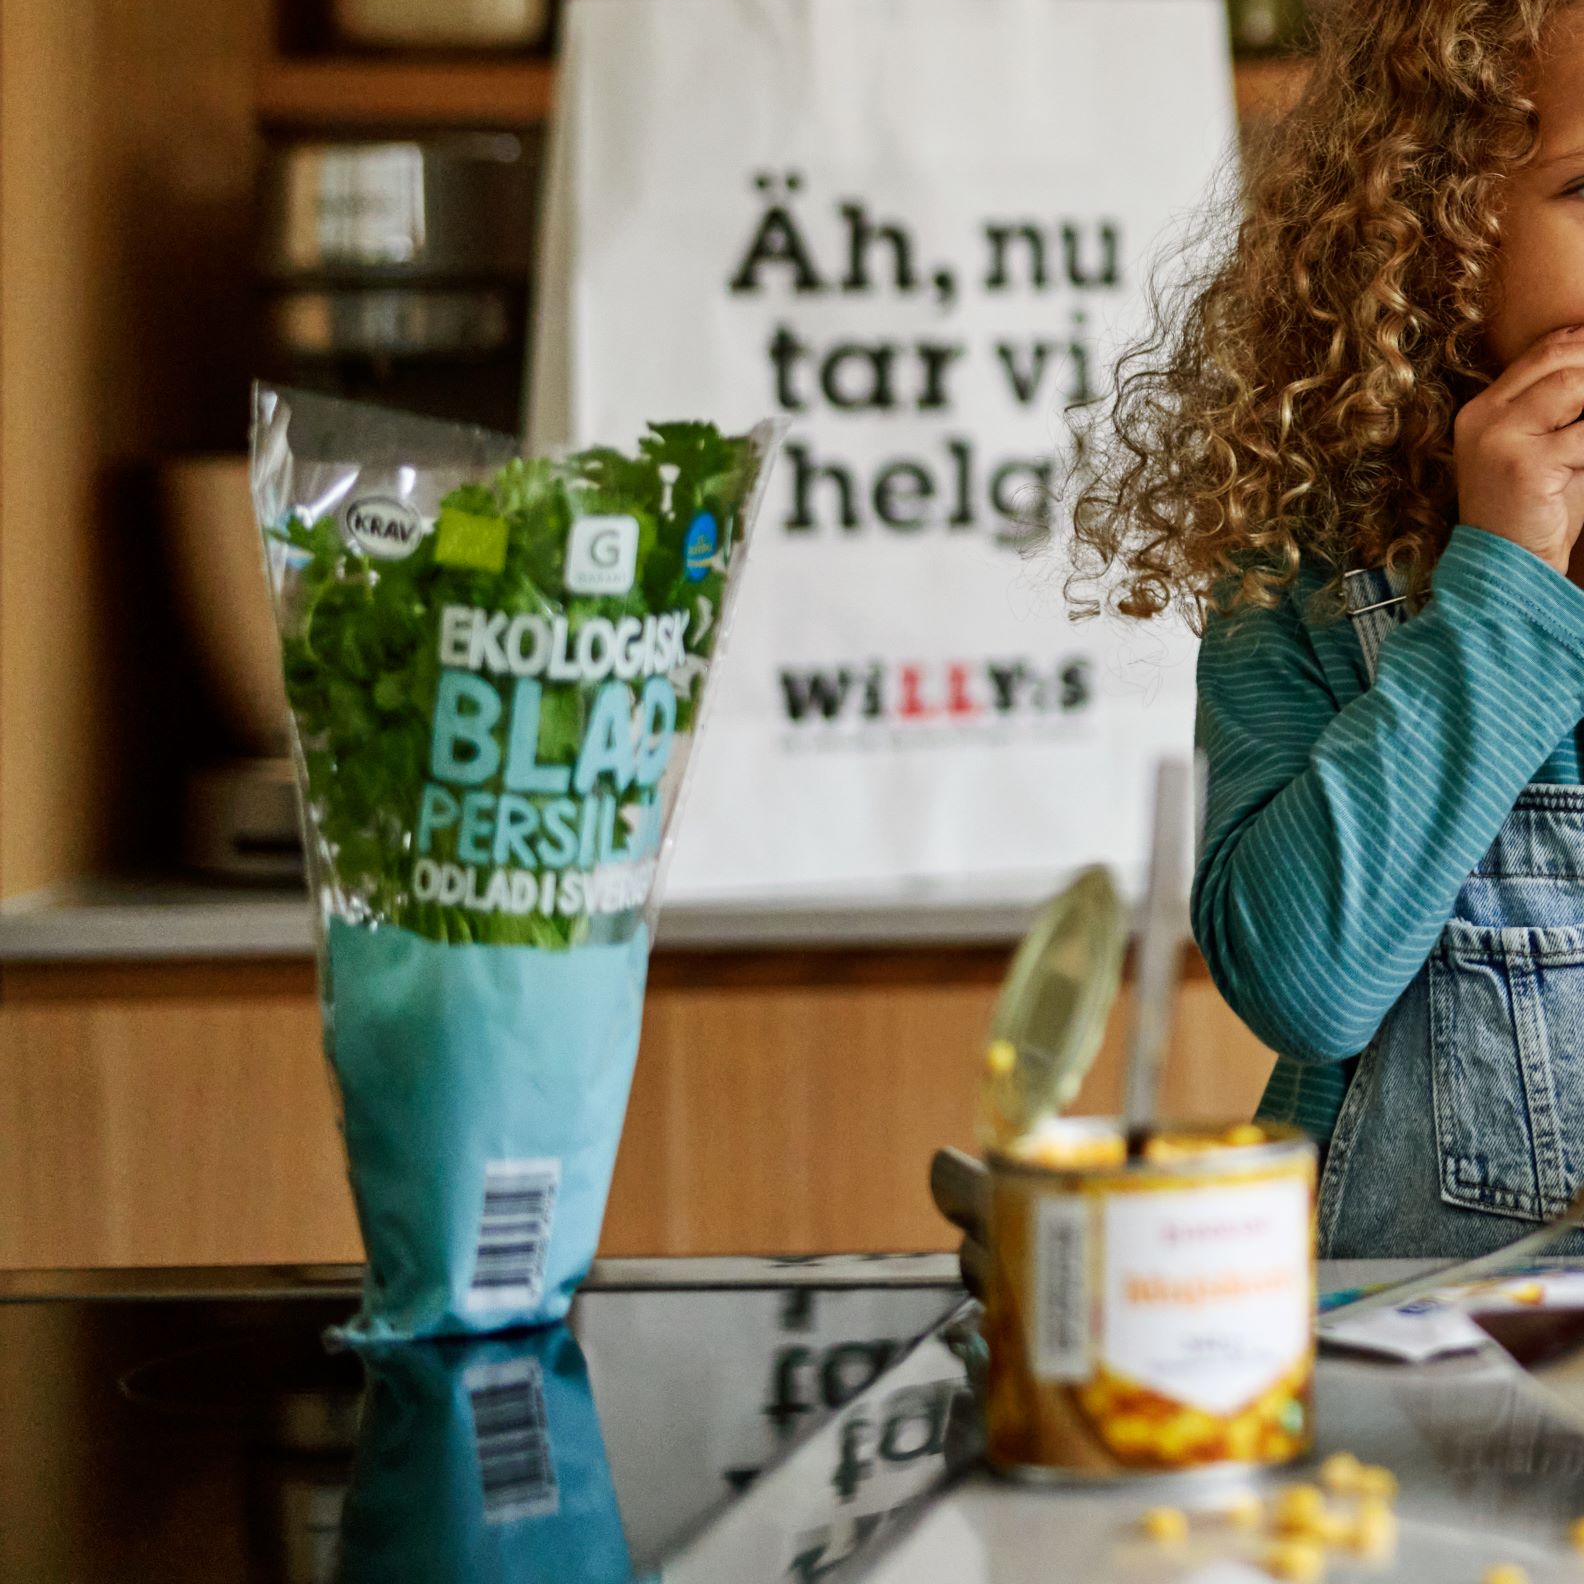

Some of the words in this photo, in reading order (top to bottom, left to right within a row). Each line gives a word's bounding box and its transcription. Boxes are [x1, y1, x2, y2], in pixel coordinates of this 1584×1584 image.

[728, 170, 957, 309] Äh,
[982, 217, 1123, 292] nu
[768, 322, 966, 413] tar
[994, 311, 1098, 405] vi
[354, 514, 416, 544] KRAV
[439, 604, 691, 681] EKOLOGISK
[430, 670, 678, 796] BLAD
[412, 857, 539, 914] ODLAD
